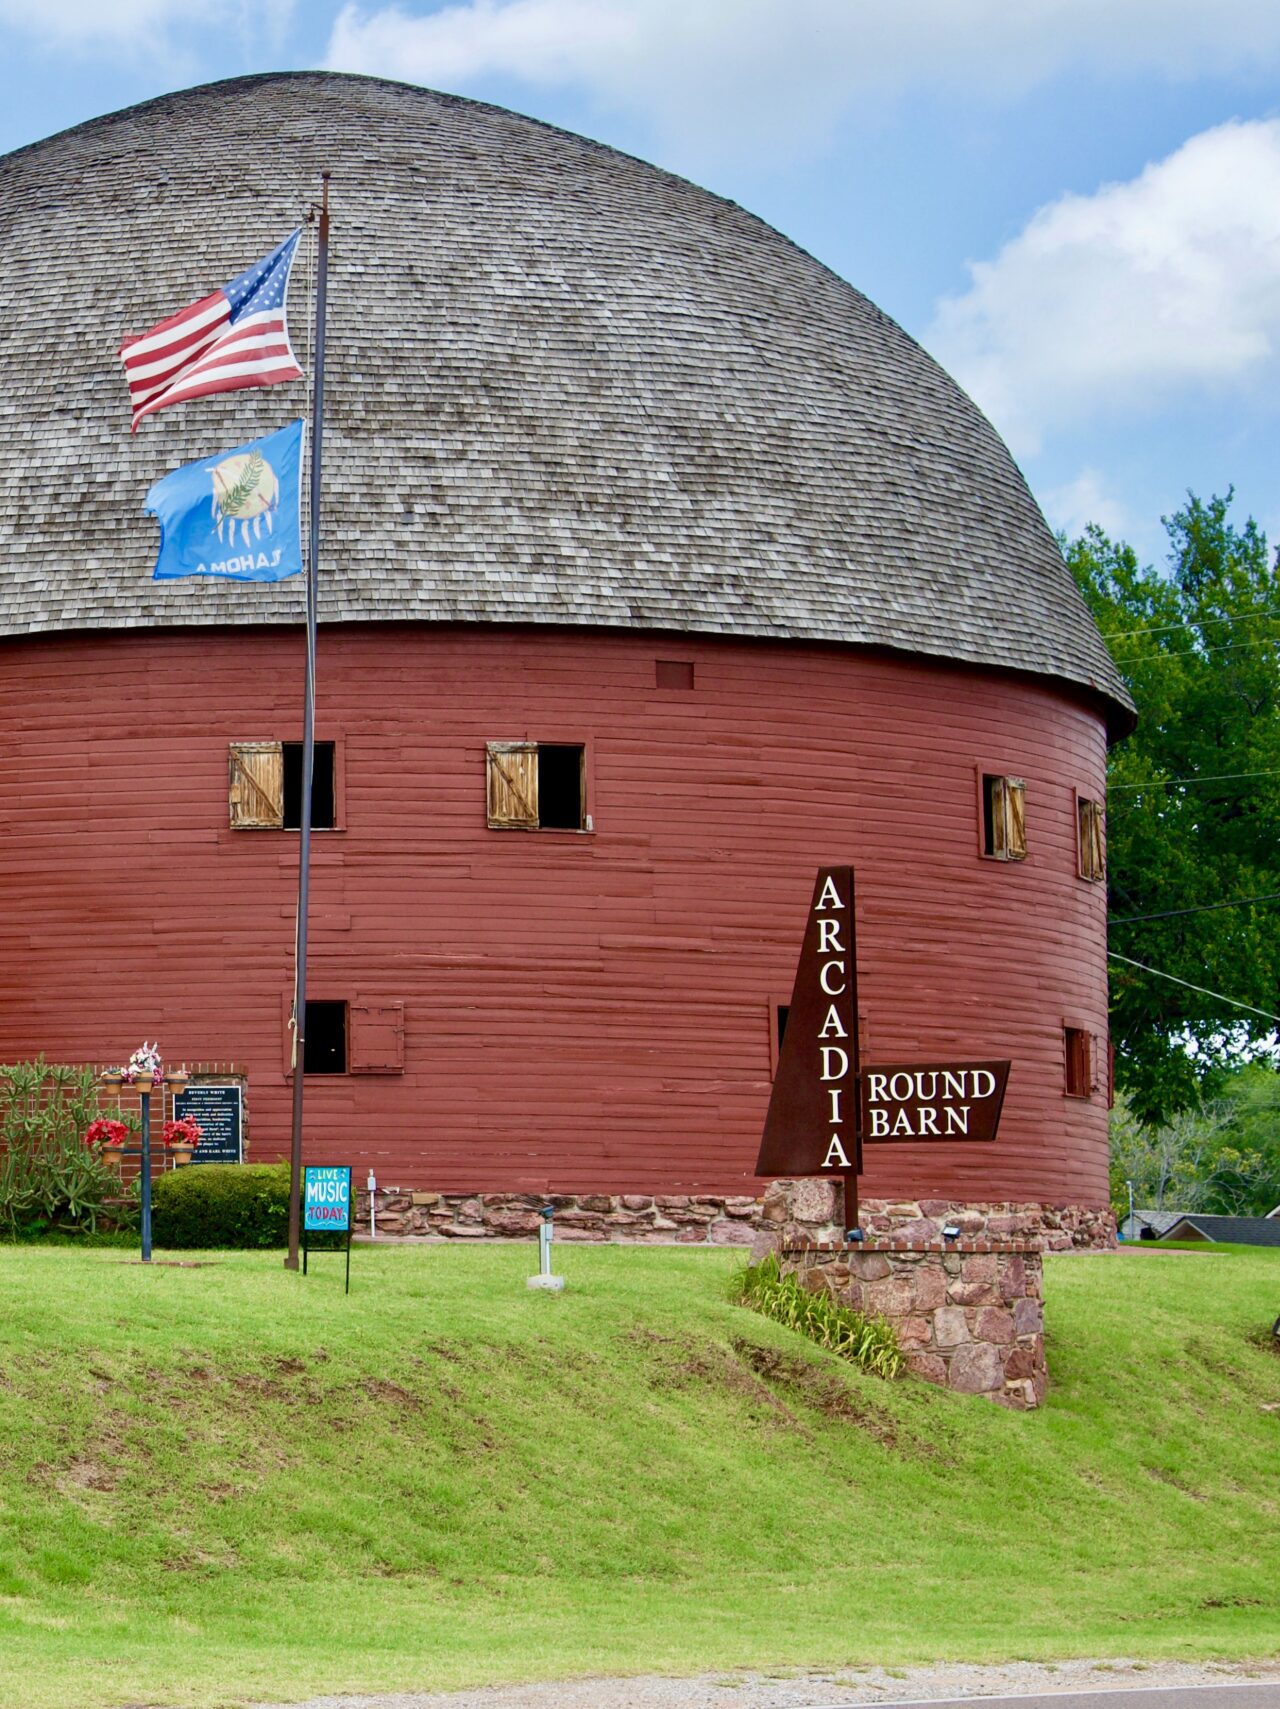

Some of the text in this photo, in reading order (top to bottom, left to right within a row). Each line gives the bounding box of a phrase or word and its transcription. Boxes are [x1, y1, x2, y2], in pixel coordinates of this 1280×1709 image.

[814, 875, 852, 1167] ARCADIA
[868, 1070, 996, 1102] ROUND
[870, 1106, 971, 1137] BARN
[317, 1169, 338, 1180] LIVE
[307, 1181, 348, 1203] MUSIC
[309, 1206, 343, 1220] TODAY
